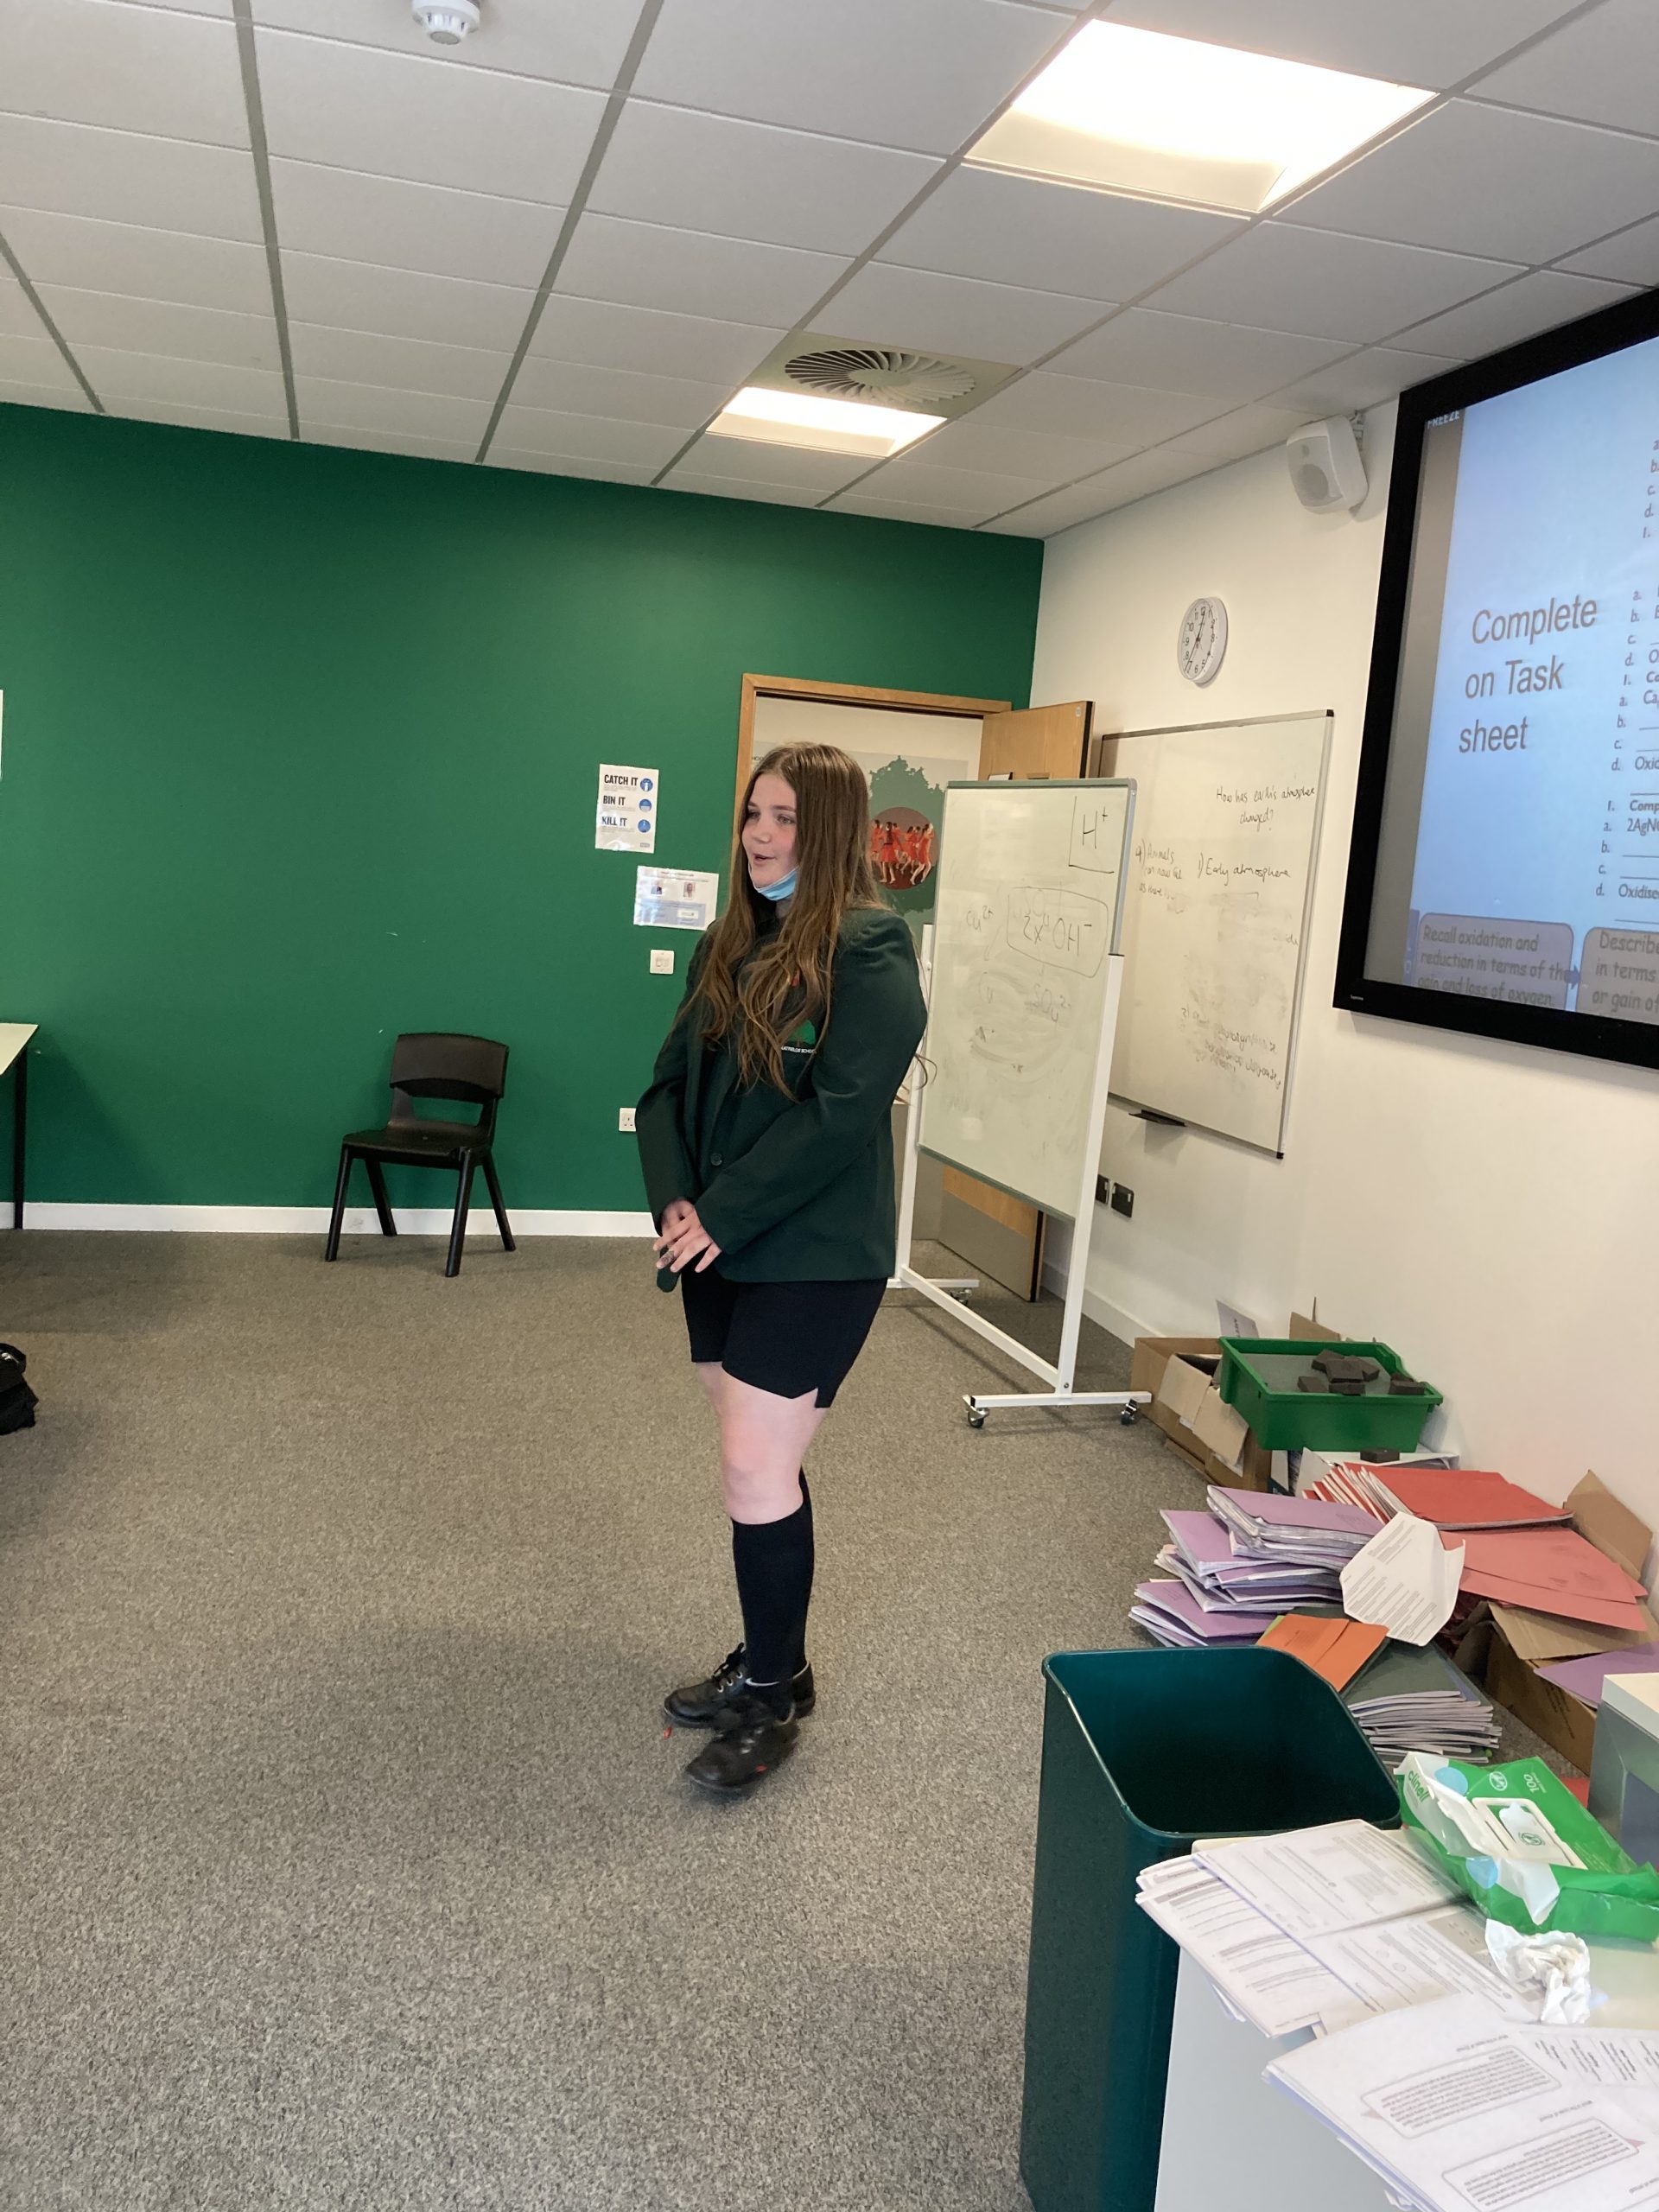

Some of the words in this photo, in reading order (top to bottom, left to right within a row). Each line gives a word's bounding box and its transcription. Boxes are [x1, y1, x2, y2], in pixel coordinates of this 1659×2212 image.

[1471, 594, 1597, 645] Complete
[1465, 671, 1495, 699] on
[1505, 655, 1565, 695] Task
[1459, 716, 1529, 753] sheet
[604, 774, 629, 785] CATCH
[631, 777, 639, 786] IT
[602, 795, 616, 805] BIN
[618, 797, 626, 806] IT
[601, 816, 618, 826] KILL
[620, 817, 627, 827] IT
[1233, 863, 1291, 883] atmosphere
[1423, 925, 1457, 944] Recall
[1459, 929, 1512, 950] oxidation
[1516, 934, 1540, 952] and
[1421, 950, 1473, 970] reduction
[1477, 954, 1487, 971] in
[1491, 957, 1527, 976] terms
[1529, 960, 1546, 979] of
[1595, 957, 1608, 976] in
[1613, 962, 1656, 982] terms
[1491, 982, 1505, 1000] of
[1592, 990, 1608, 1004] or
[1611, 990, 1642, 1013] gain
[1408, 1770, 1430, 1802] clinell
